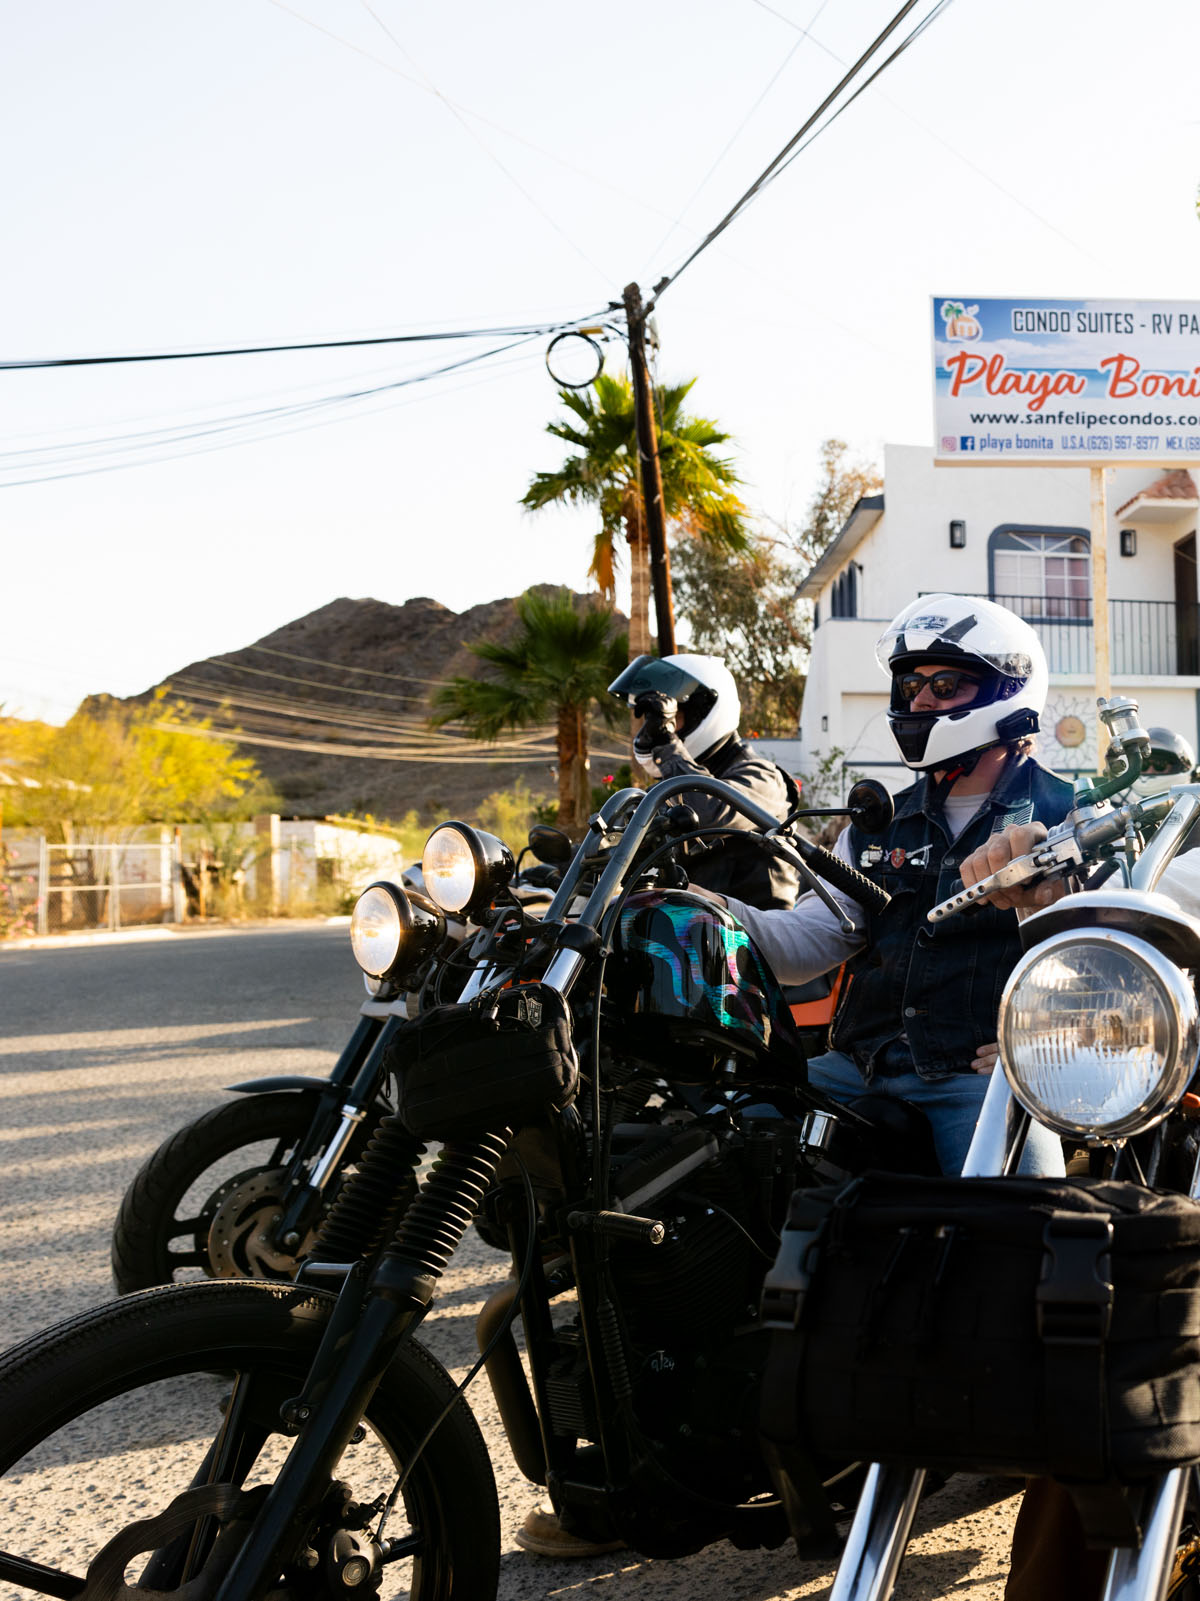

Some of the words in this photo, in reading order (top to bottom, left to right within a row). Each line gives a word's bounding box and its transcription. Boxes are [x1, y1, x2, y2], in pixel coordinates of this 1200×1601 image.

[1013, 310, 1071, 333] CONDO
[1077, 312, 1134, 334] SUITES
[1152, 313, 1172, 335] RV
[946, 350, 1086, 412] Playa
[979, 433, 1012, 452] playa
[1016, 433, 1054, 450] bonita
